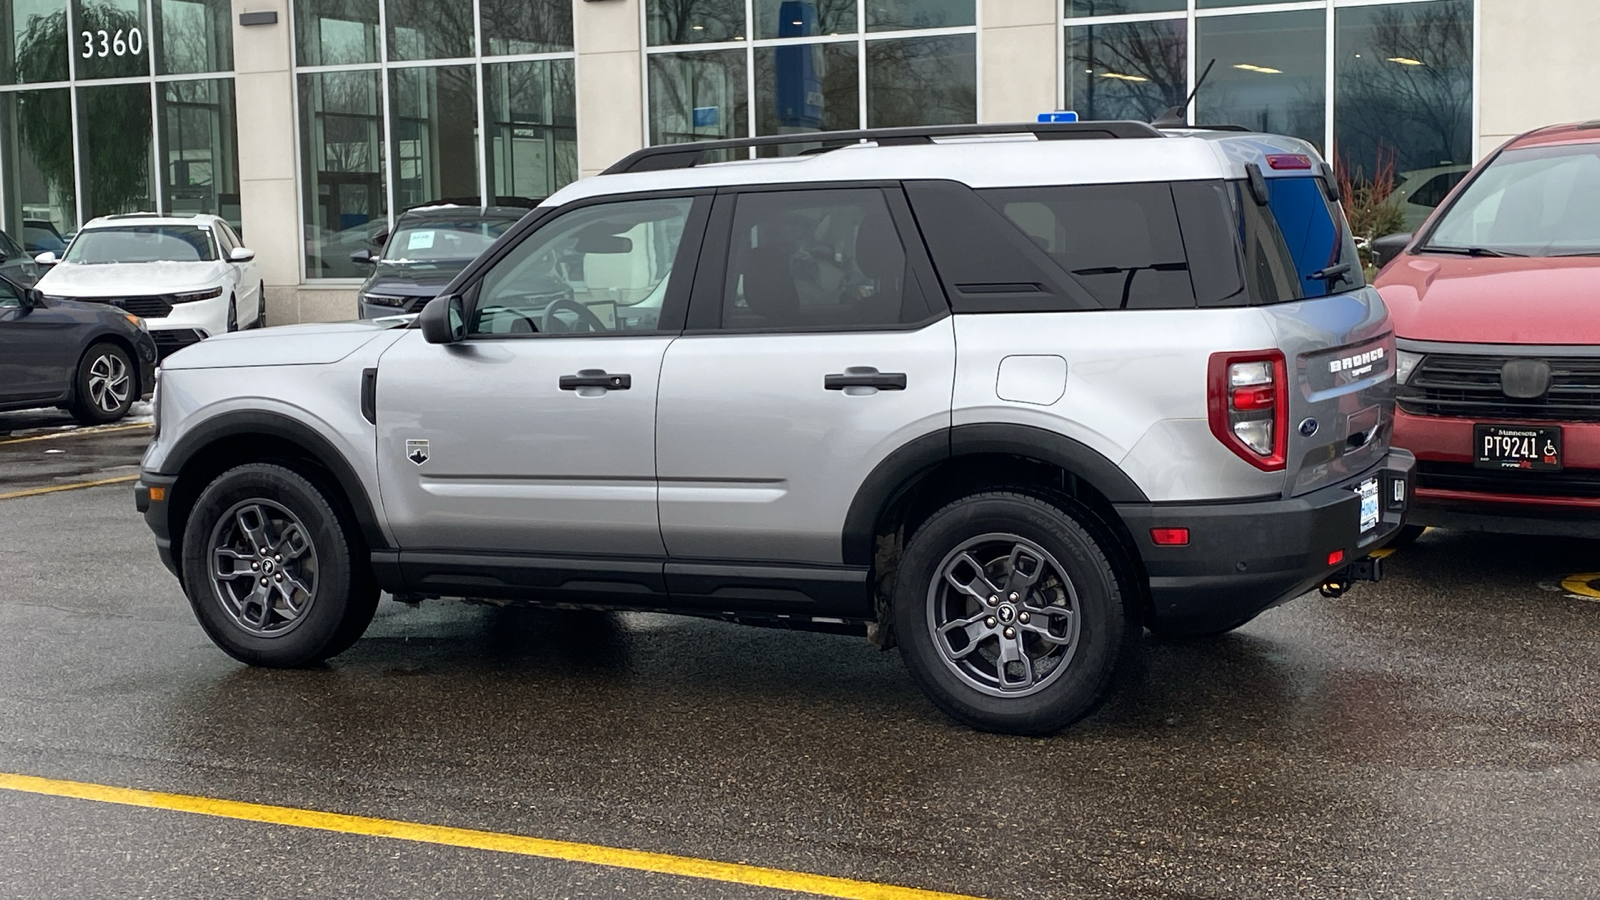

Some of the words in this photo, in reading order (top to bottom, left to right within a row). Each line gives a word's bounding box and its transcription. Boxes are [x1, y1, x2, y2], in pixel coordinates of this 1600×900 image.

[81, 27, 142, 58] 3360
[1329, 347, 1384, 373] BRONCO
[1351, 364, 1373, 377] SPORT
[1498, 429, 1537, 437] Minnesota
[1484, 435, 1538, 458] PT9241
